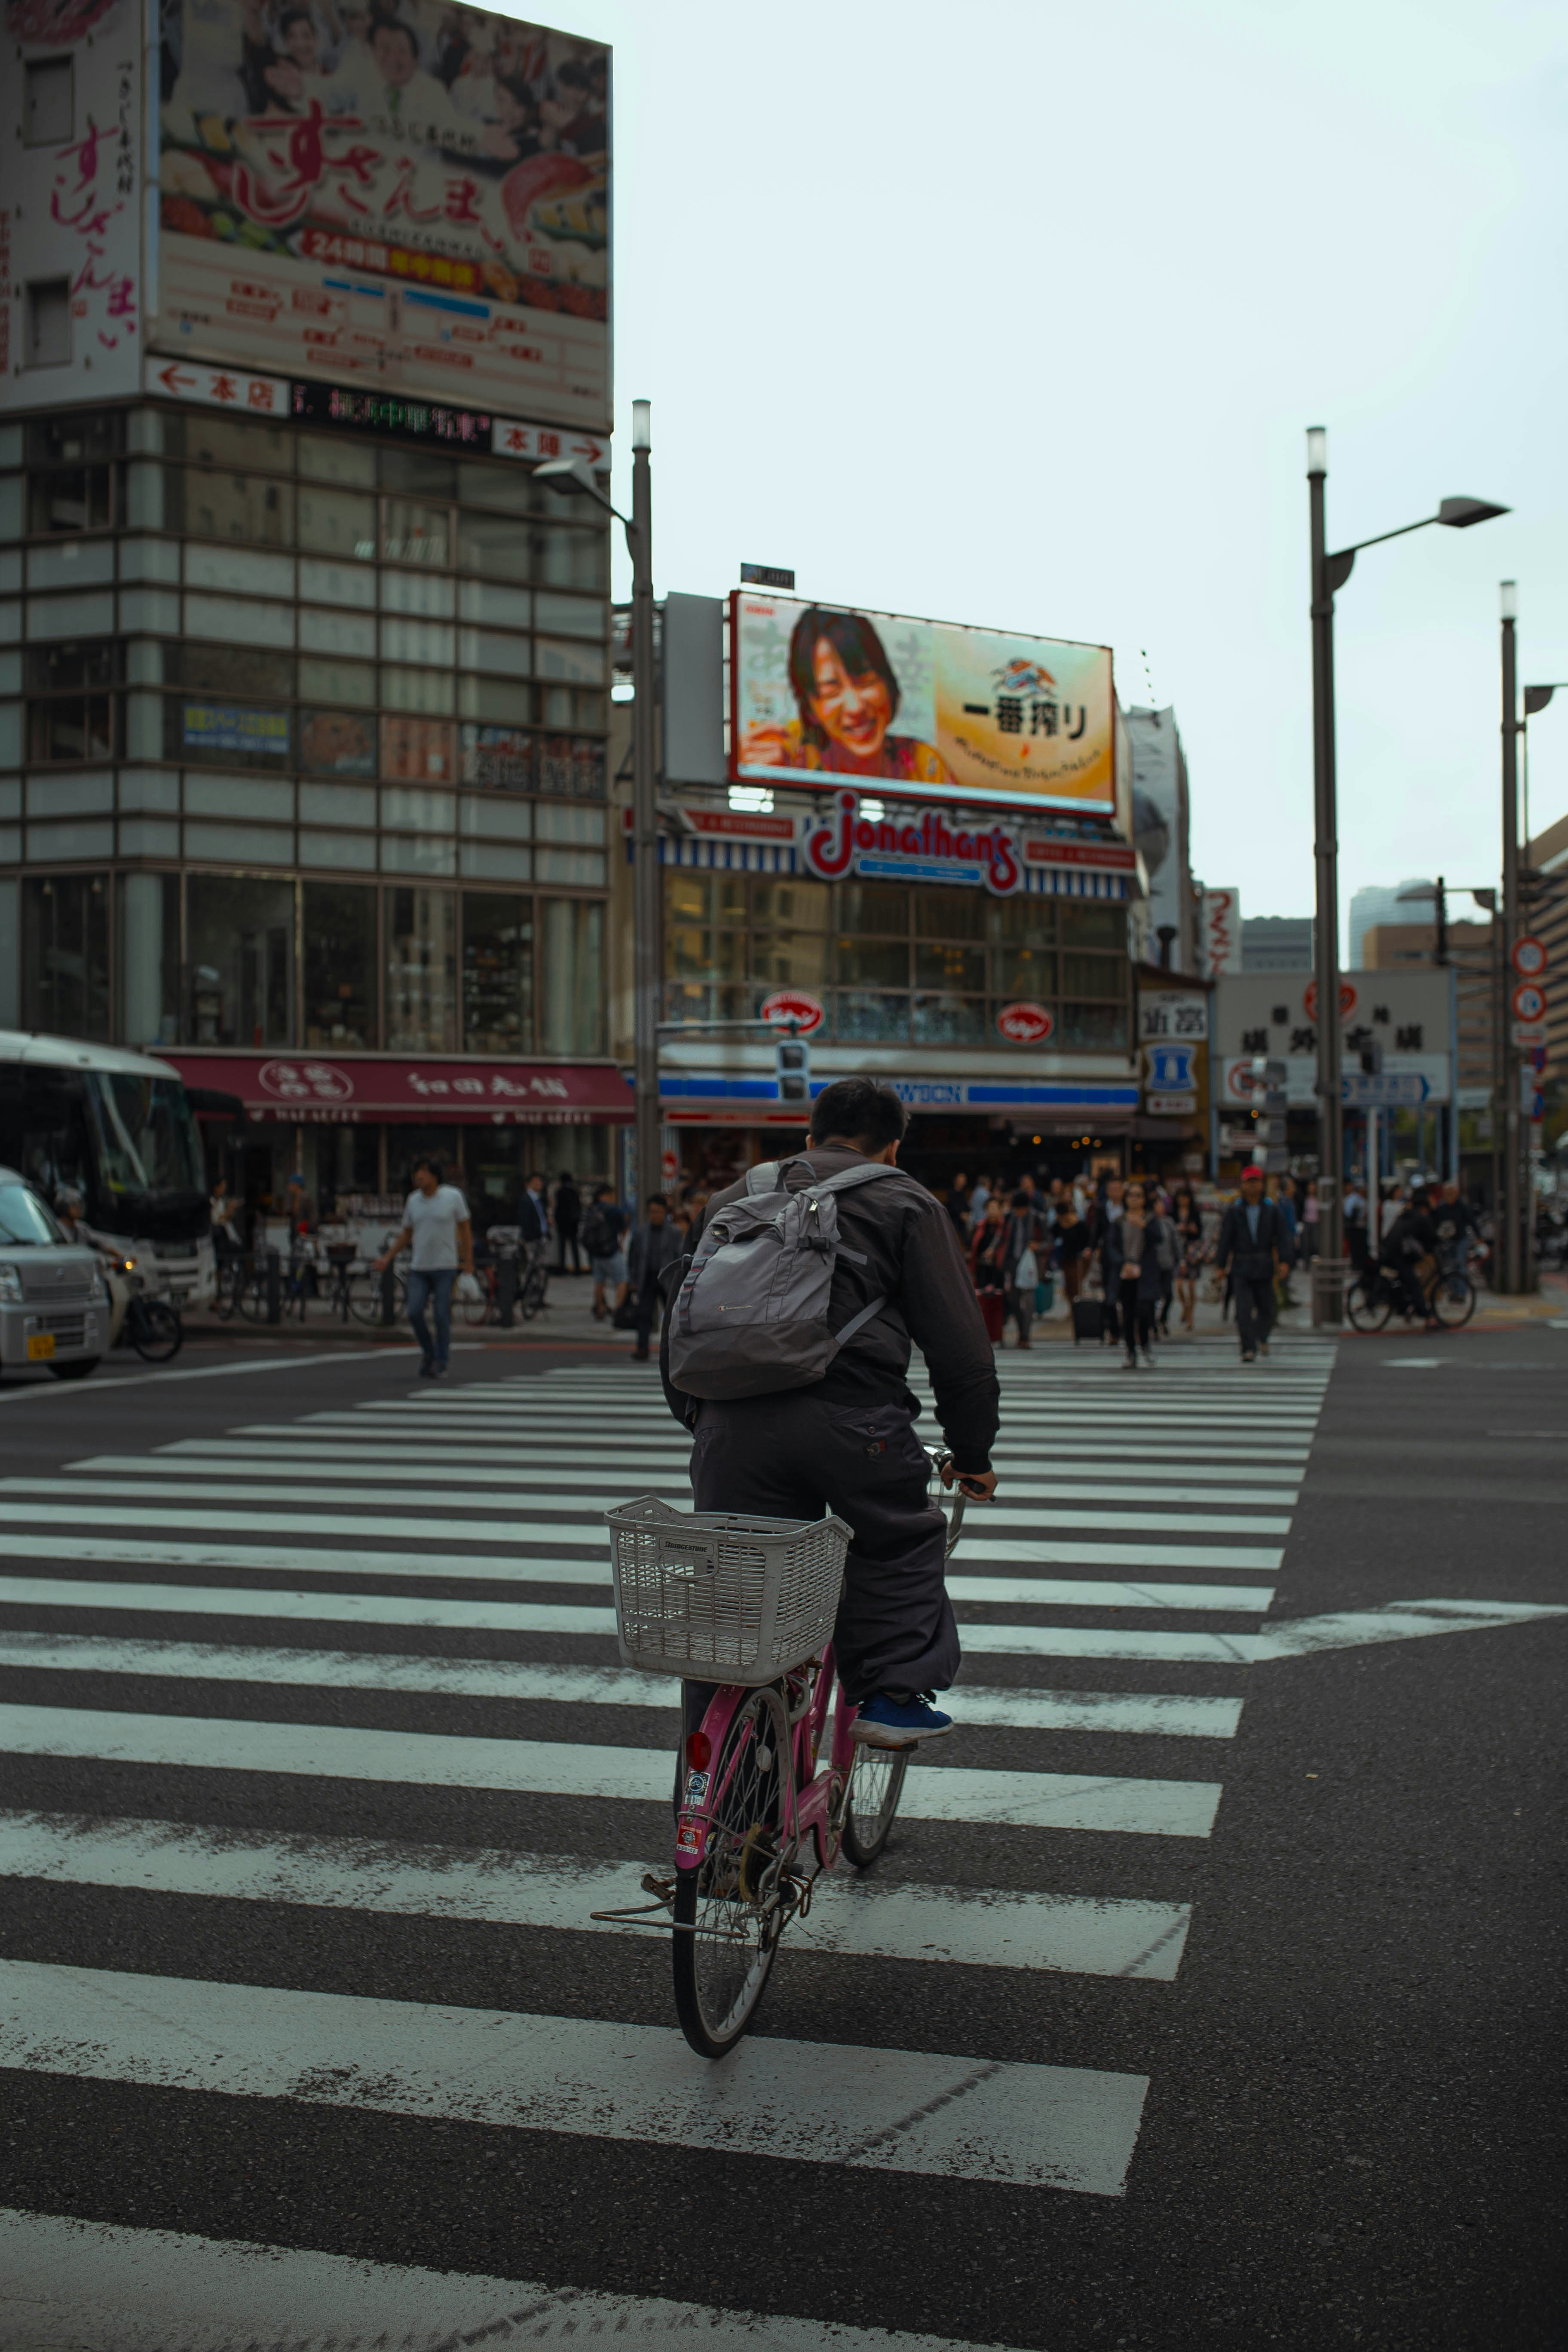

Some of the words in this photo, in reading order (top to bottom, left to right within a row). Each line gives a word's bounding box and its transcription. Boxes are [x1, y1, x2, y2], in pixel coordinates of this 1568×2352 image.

[211, 373, 274, 409] 本店
[963, 696, 1087, 741] 一番搾り
[664, 1540, 708, 1552] BRIDGESTONE
